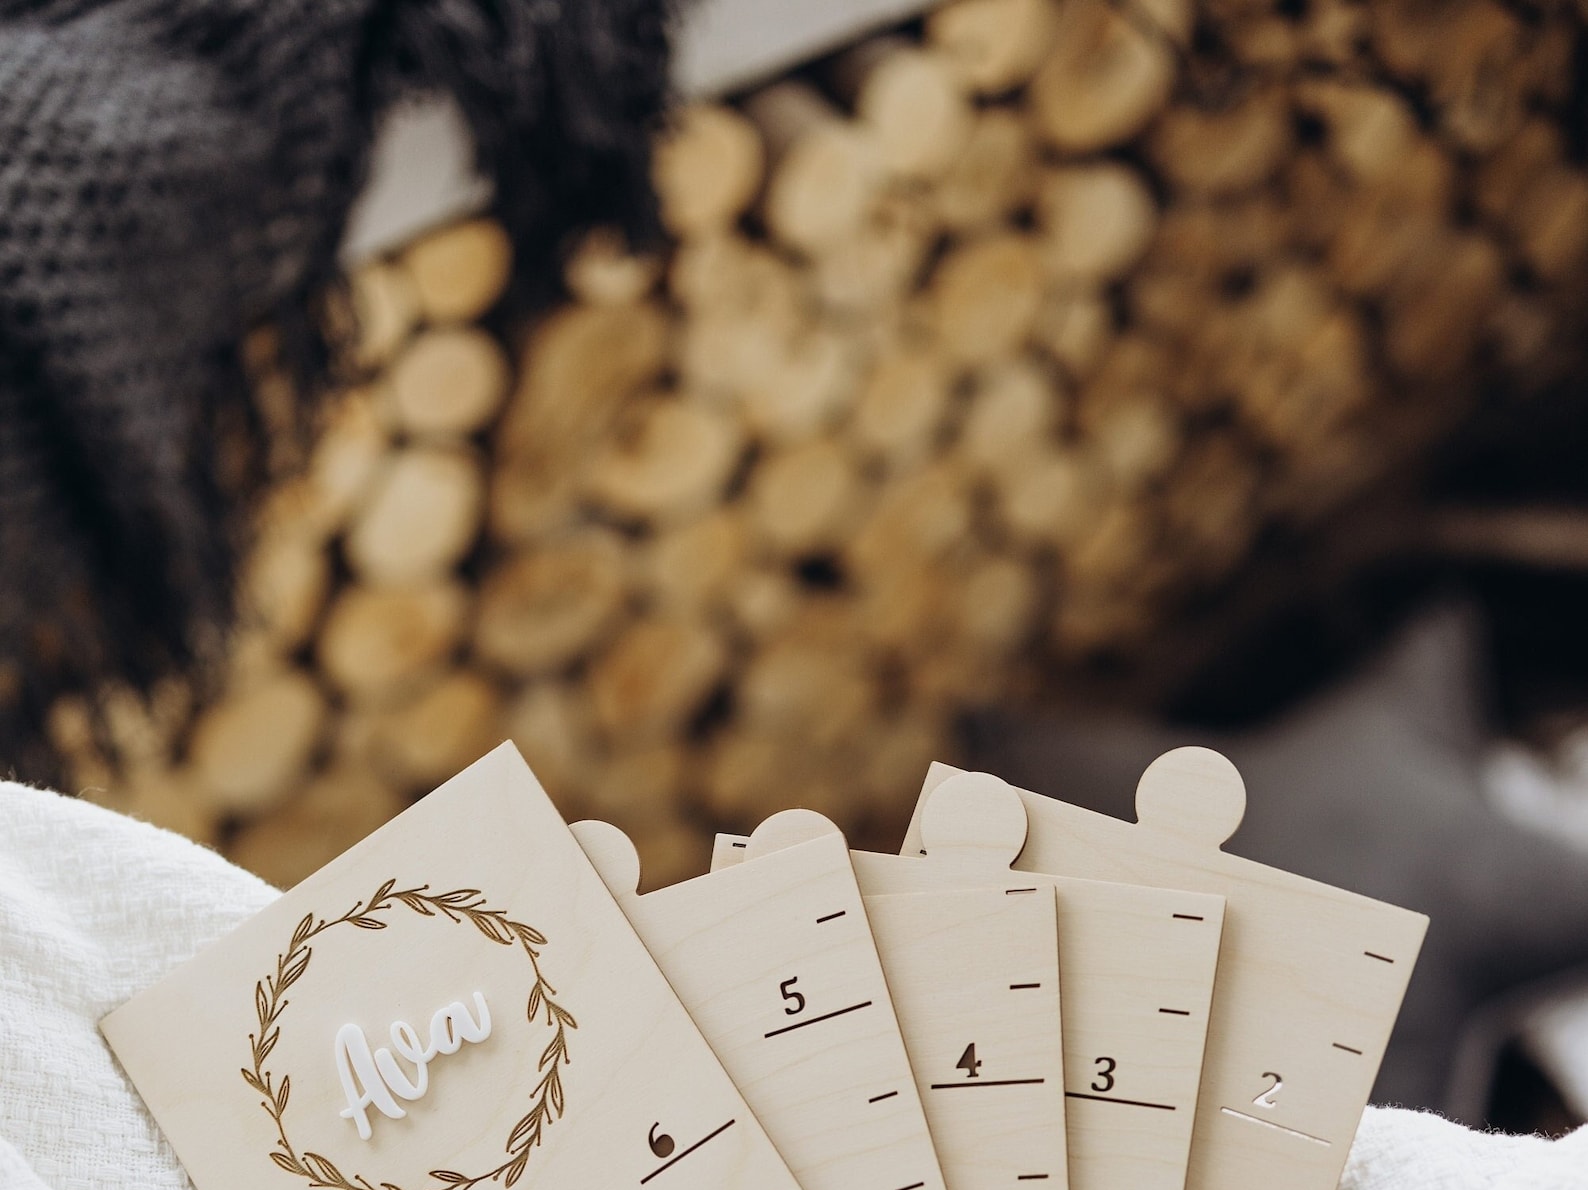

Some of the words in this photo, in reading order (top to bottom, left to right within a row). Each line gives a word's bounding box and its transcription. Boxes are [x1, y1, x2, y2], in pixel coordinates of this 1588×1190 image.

[779, 975, 806, 1016] 5
[335, 991, 492, 1141] Ava
[955, 1042, 983, 1079] 4
[1090, 1056, 1117, 1093] 3
[1251, 1071, 1283, 1108] 2
[648, 1121, 676, 1159] 6
